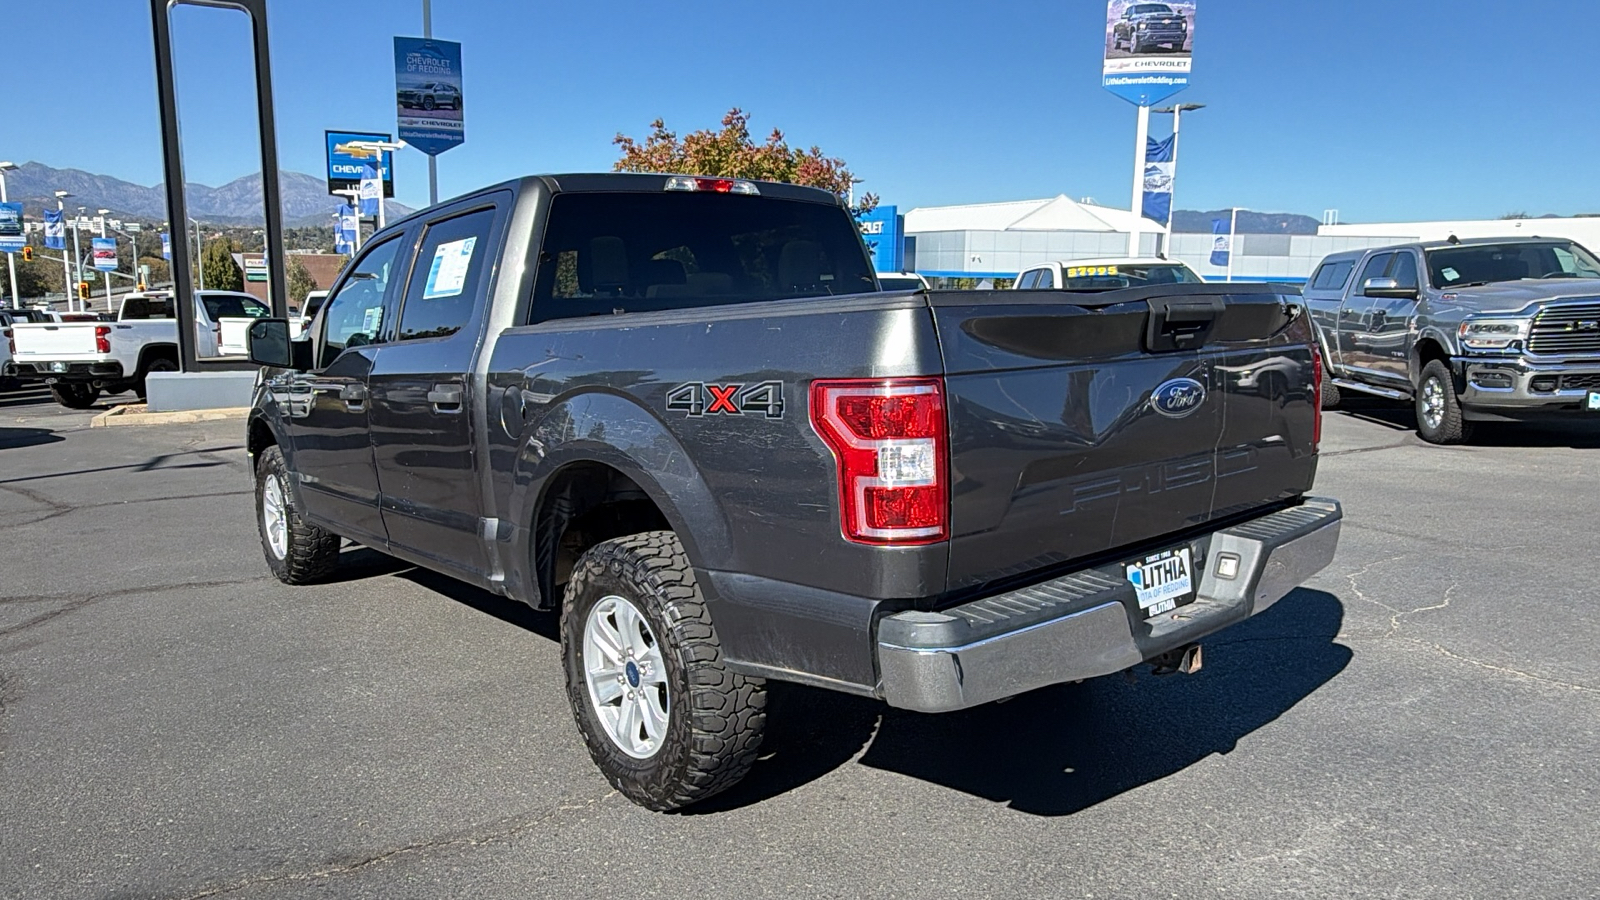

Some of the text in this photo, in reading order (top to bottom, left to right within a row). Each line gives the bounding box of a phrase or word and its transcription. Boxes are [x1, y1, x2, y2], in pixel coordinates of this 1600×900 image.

[406, 56, 450, 67] CHEVROLET
[419, 66, 451, 75] REDDING
[1105, 76, 1187, 86] LithiaChevroletRedding.com
[421, 120, 462, 128] CHEVROLET
[332, 164, 388, 175] CHEVRT
[1166, 386, 1201, 409] Ford
[1142, 557, 1187, 590] LITHIA
[1140, 578, 1189, 601] OTA OF REDDING
